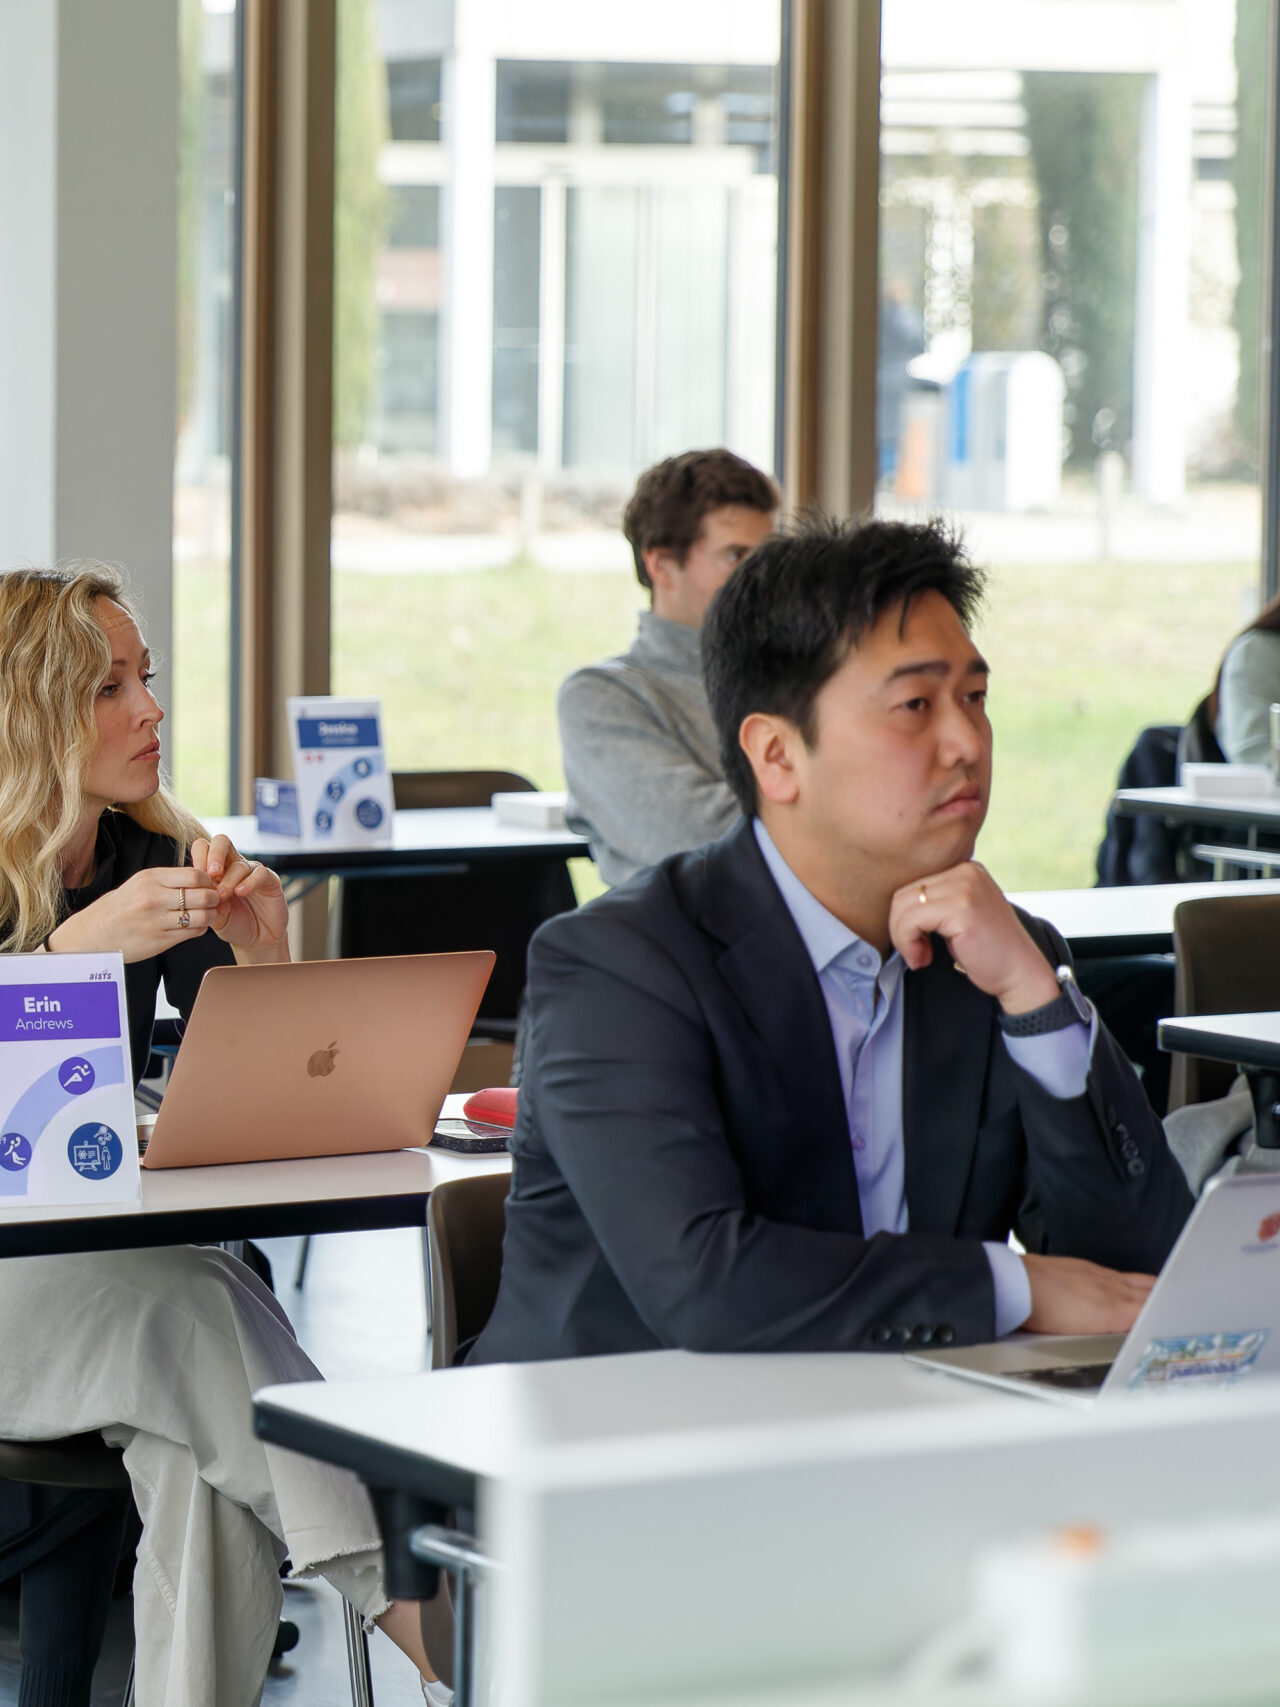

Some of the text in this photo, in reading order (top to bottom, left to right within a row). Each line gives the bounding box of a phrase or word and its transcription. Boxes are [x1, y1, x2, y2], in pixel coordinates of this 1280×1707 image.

[89, 971, 112, 980] aists
[23, 996, 61, 1013] Erin
[15, 1018, 74, 1030] Andrews
